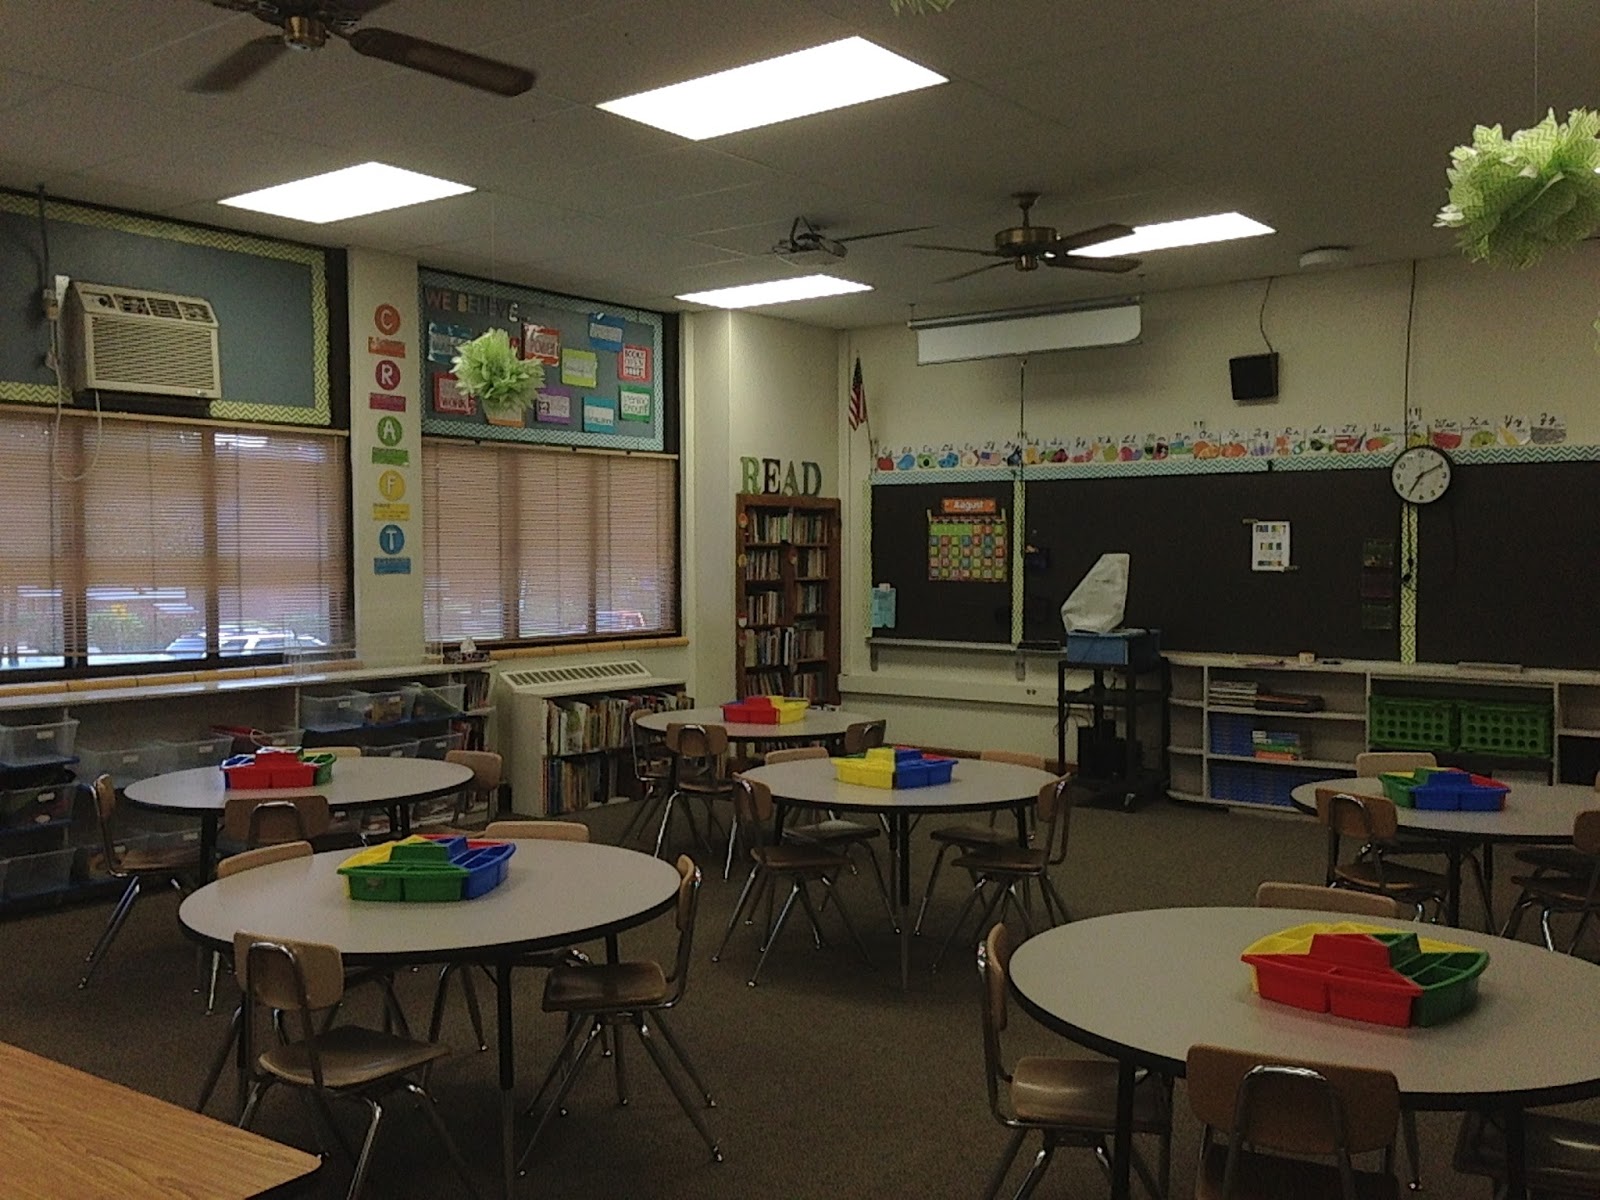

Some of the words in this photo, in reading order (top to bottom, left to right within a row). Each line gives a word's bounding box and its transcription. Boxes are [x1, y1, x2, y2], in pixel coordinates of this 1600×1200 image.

[380, 309, 394, 329] C
[381, 364, 394, 386] R
[383, 420, 397, 441] A
[386, 475, 396, 495] F
[740, 456, 822, 497] READ
[953, 499, 984, 511] August
[385, 530, 397, 551] T
